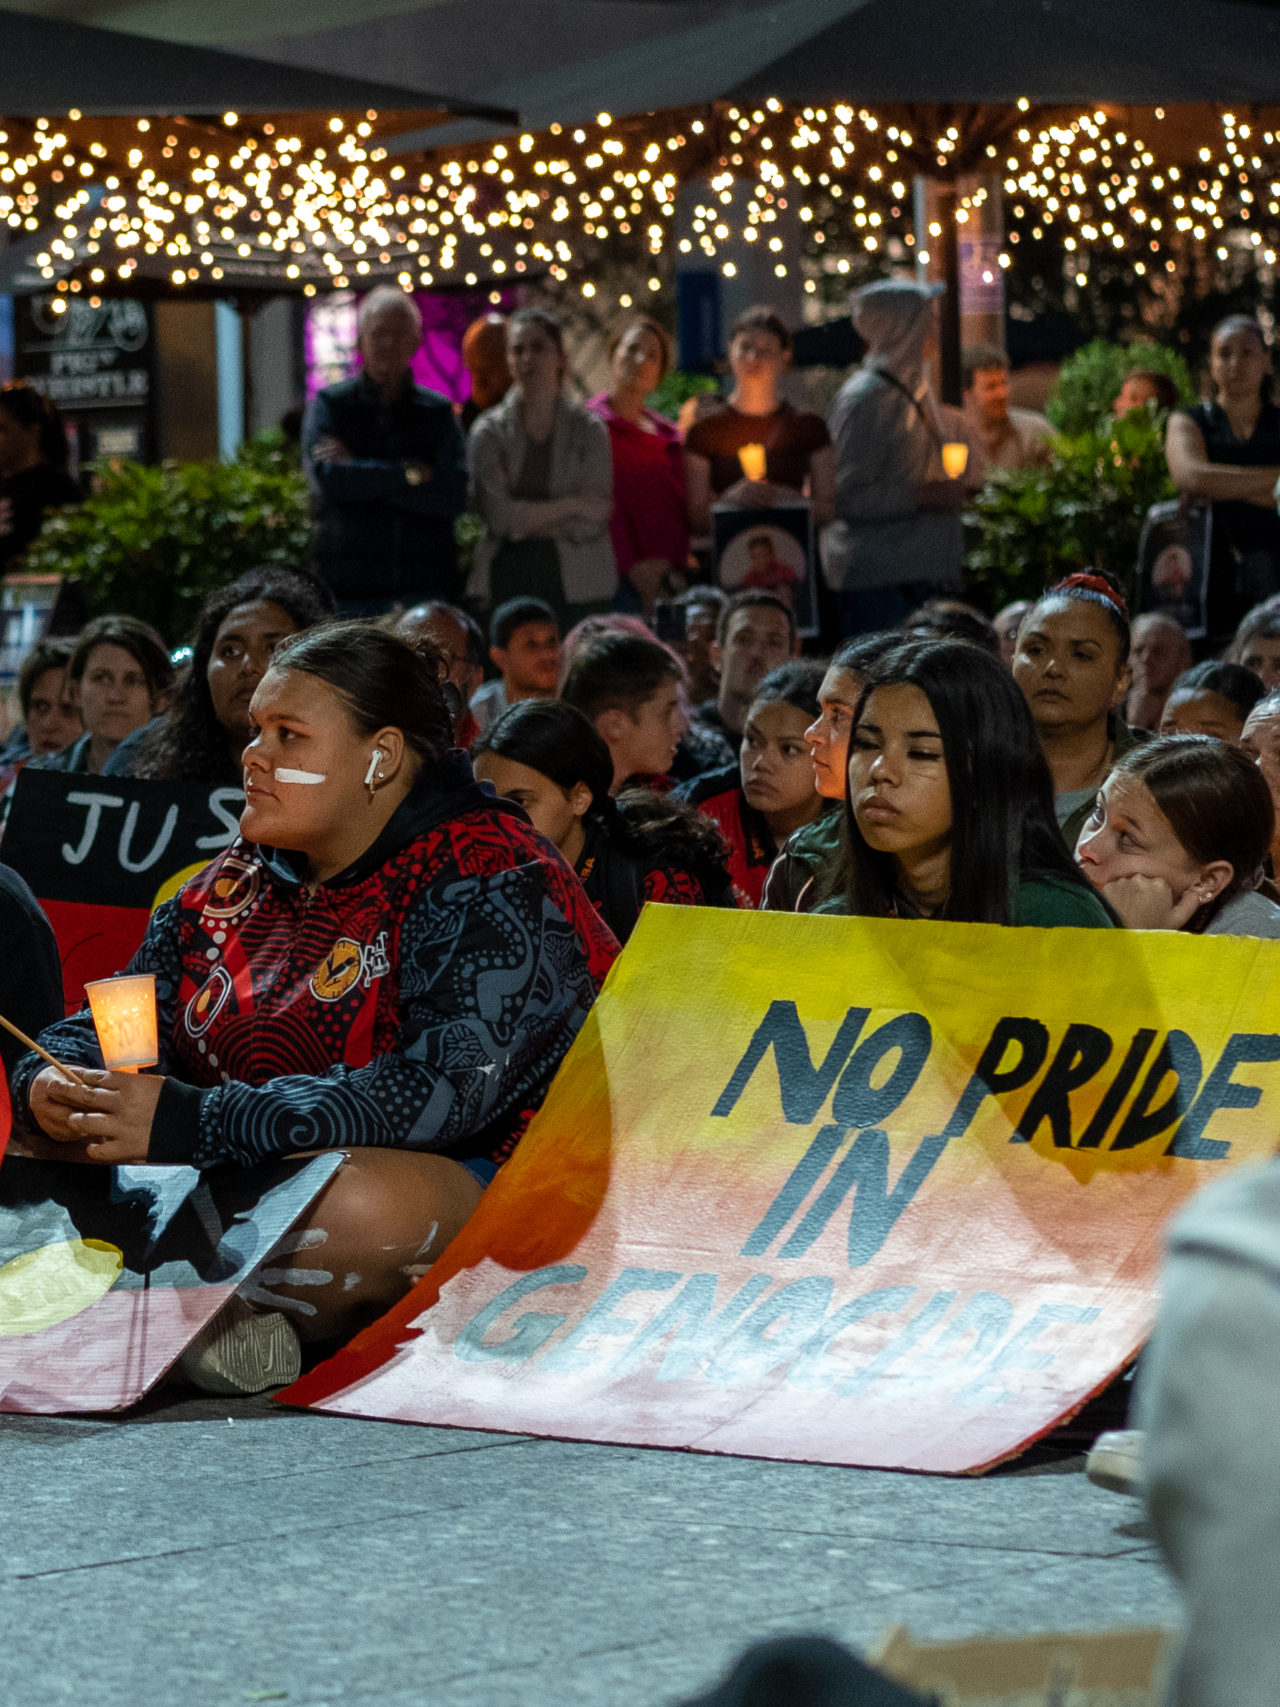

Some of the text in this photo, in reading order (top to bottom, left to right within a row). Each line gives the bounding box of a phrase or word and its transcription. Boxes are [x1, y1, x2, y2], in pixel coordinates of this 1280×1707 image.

[62, 786, 247, 873] JUS
[710, 1000, 1280, 1161] NO PRIDE
[738, 1123, 949, 1269] IN
[453, 1264, 1102, 1406] GENOCIDE
